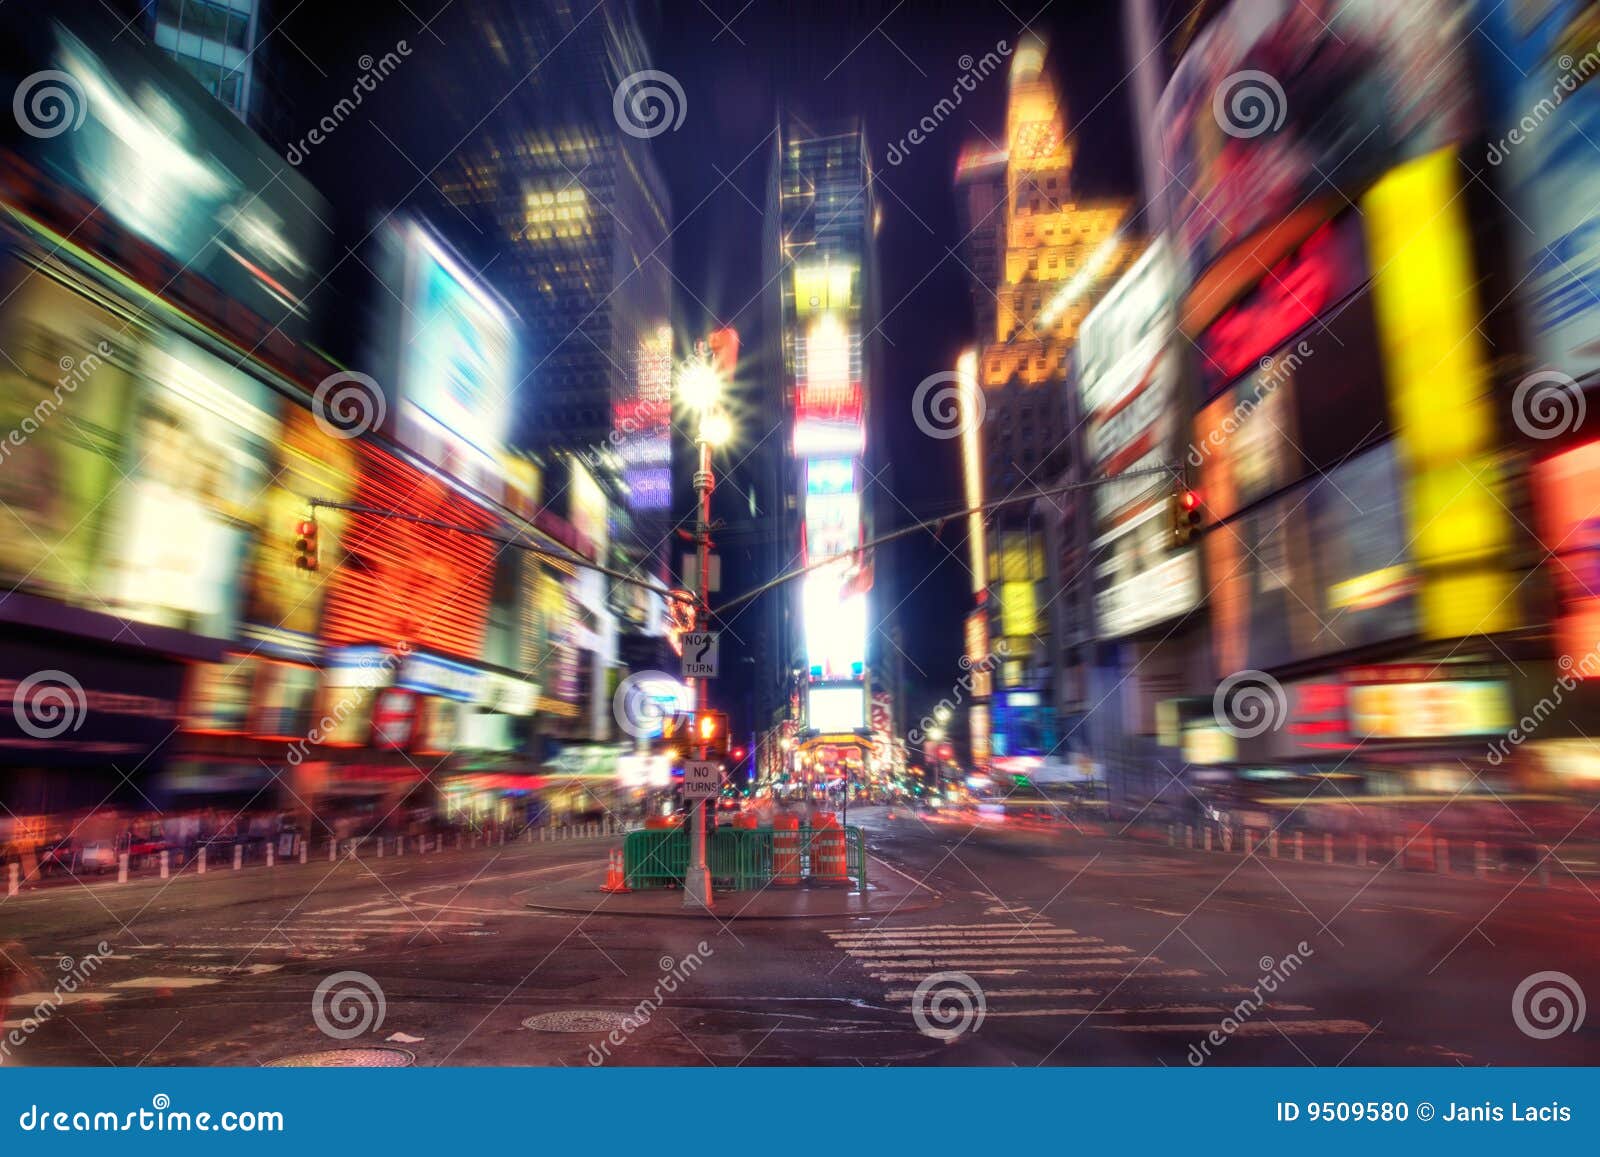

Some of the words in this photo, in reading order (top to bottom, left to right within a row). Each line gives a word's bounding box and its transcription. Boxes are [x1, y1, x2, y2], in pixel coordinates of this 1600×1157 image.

[685, 634, 702, 646] NO
[686, 663, 713, 673] TURN
[693, 766, 709, 778] NO
[686, 782, 717, 792] TURNS
